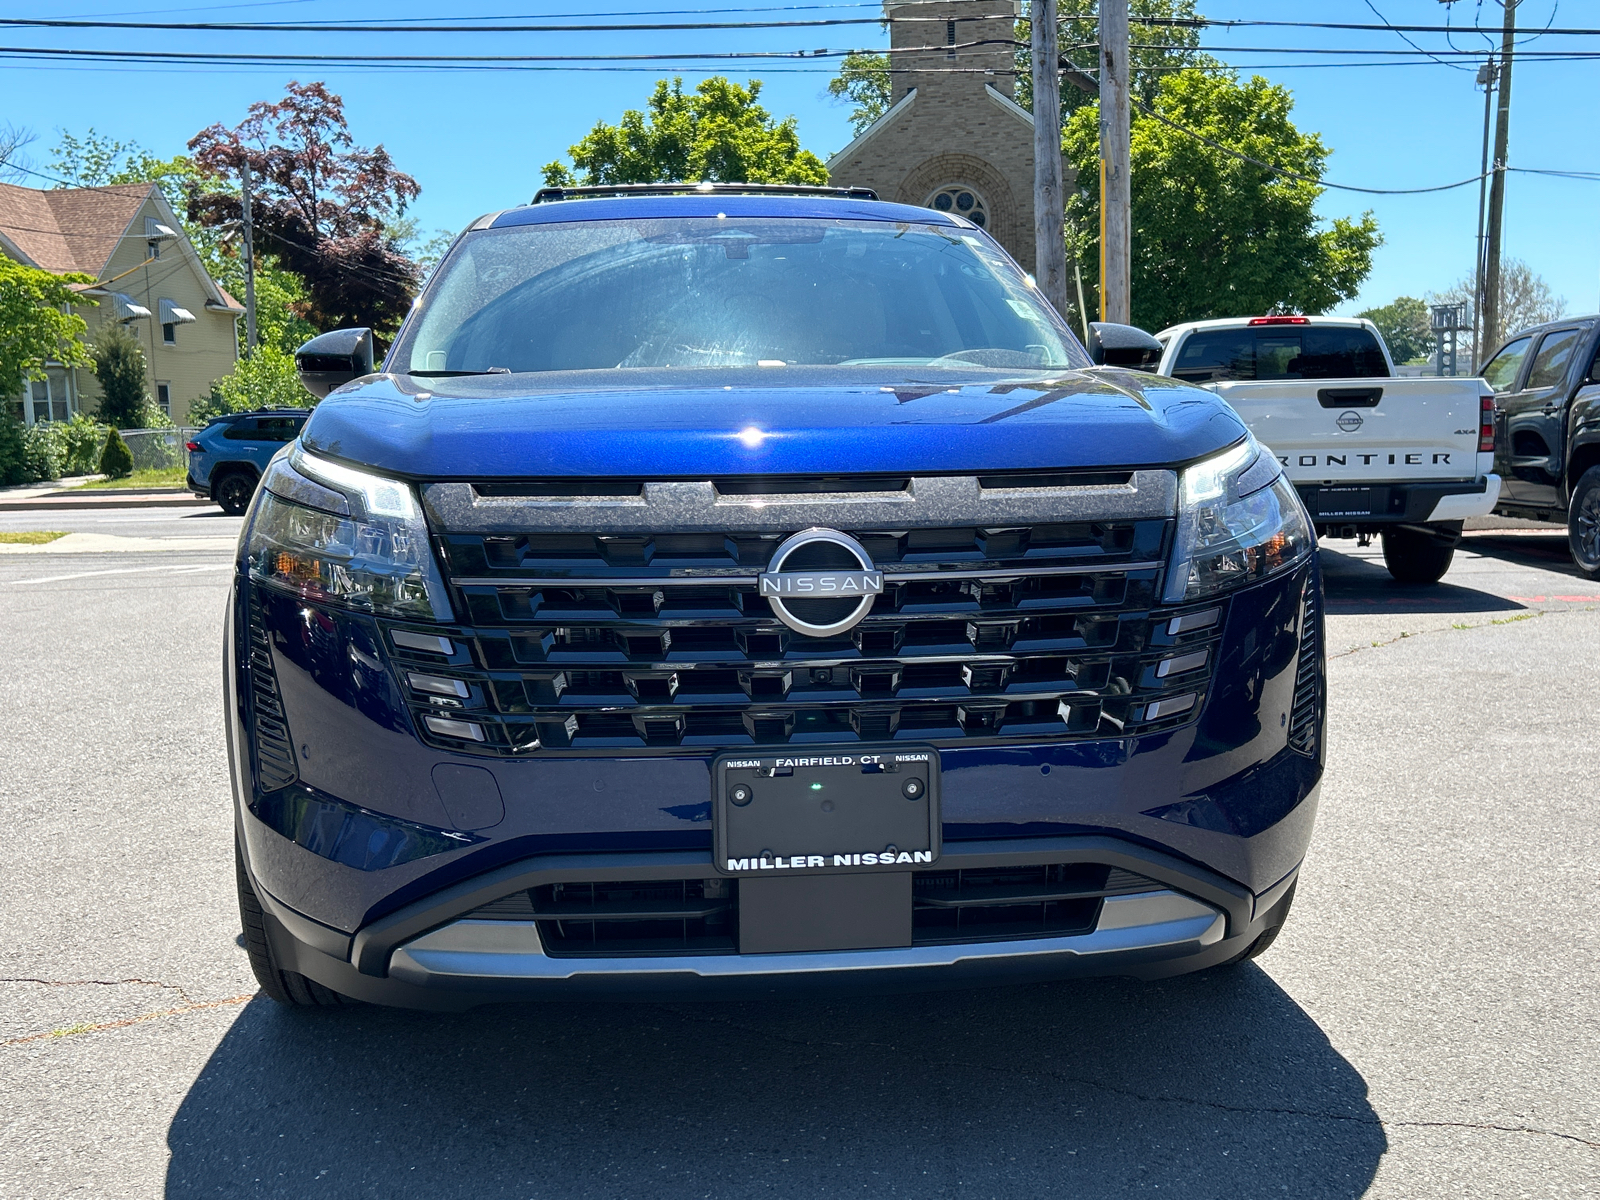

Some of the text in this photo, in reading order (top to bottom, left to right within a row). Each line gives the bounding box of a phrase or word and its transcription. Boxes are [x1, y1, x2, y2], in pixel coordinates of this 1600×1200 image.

[1276, 453, 1451, 467] RONTIER
[763, 575, 880, 593] NISSAN
[727, 760, 761, 768] NISSAN
[775, 755, 881, 768] FAIRFIELD, CT
[895, 754, 929, 762] NISSAN
[727, 850, 932, 871] MILLER NISSAN
